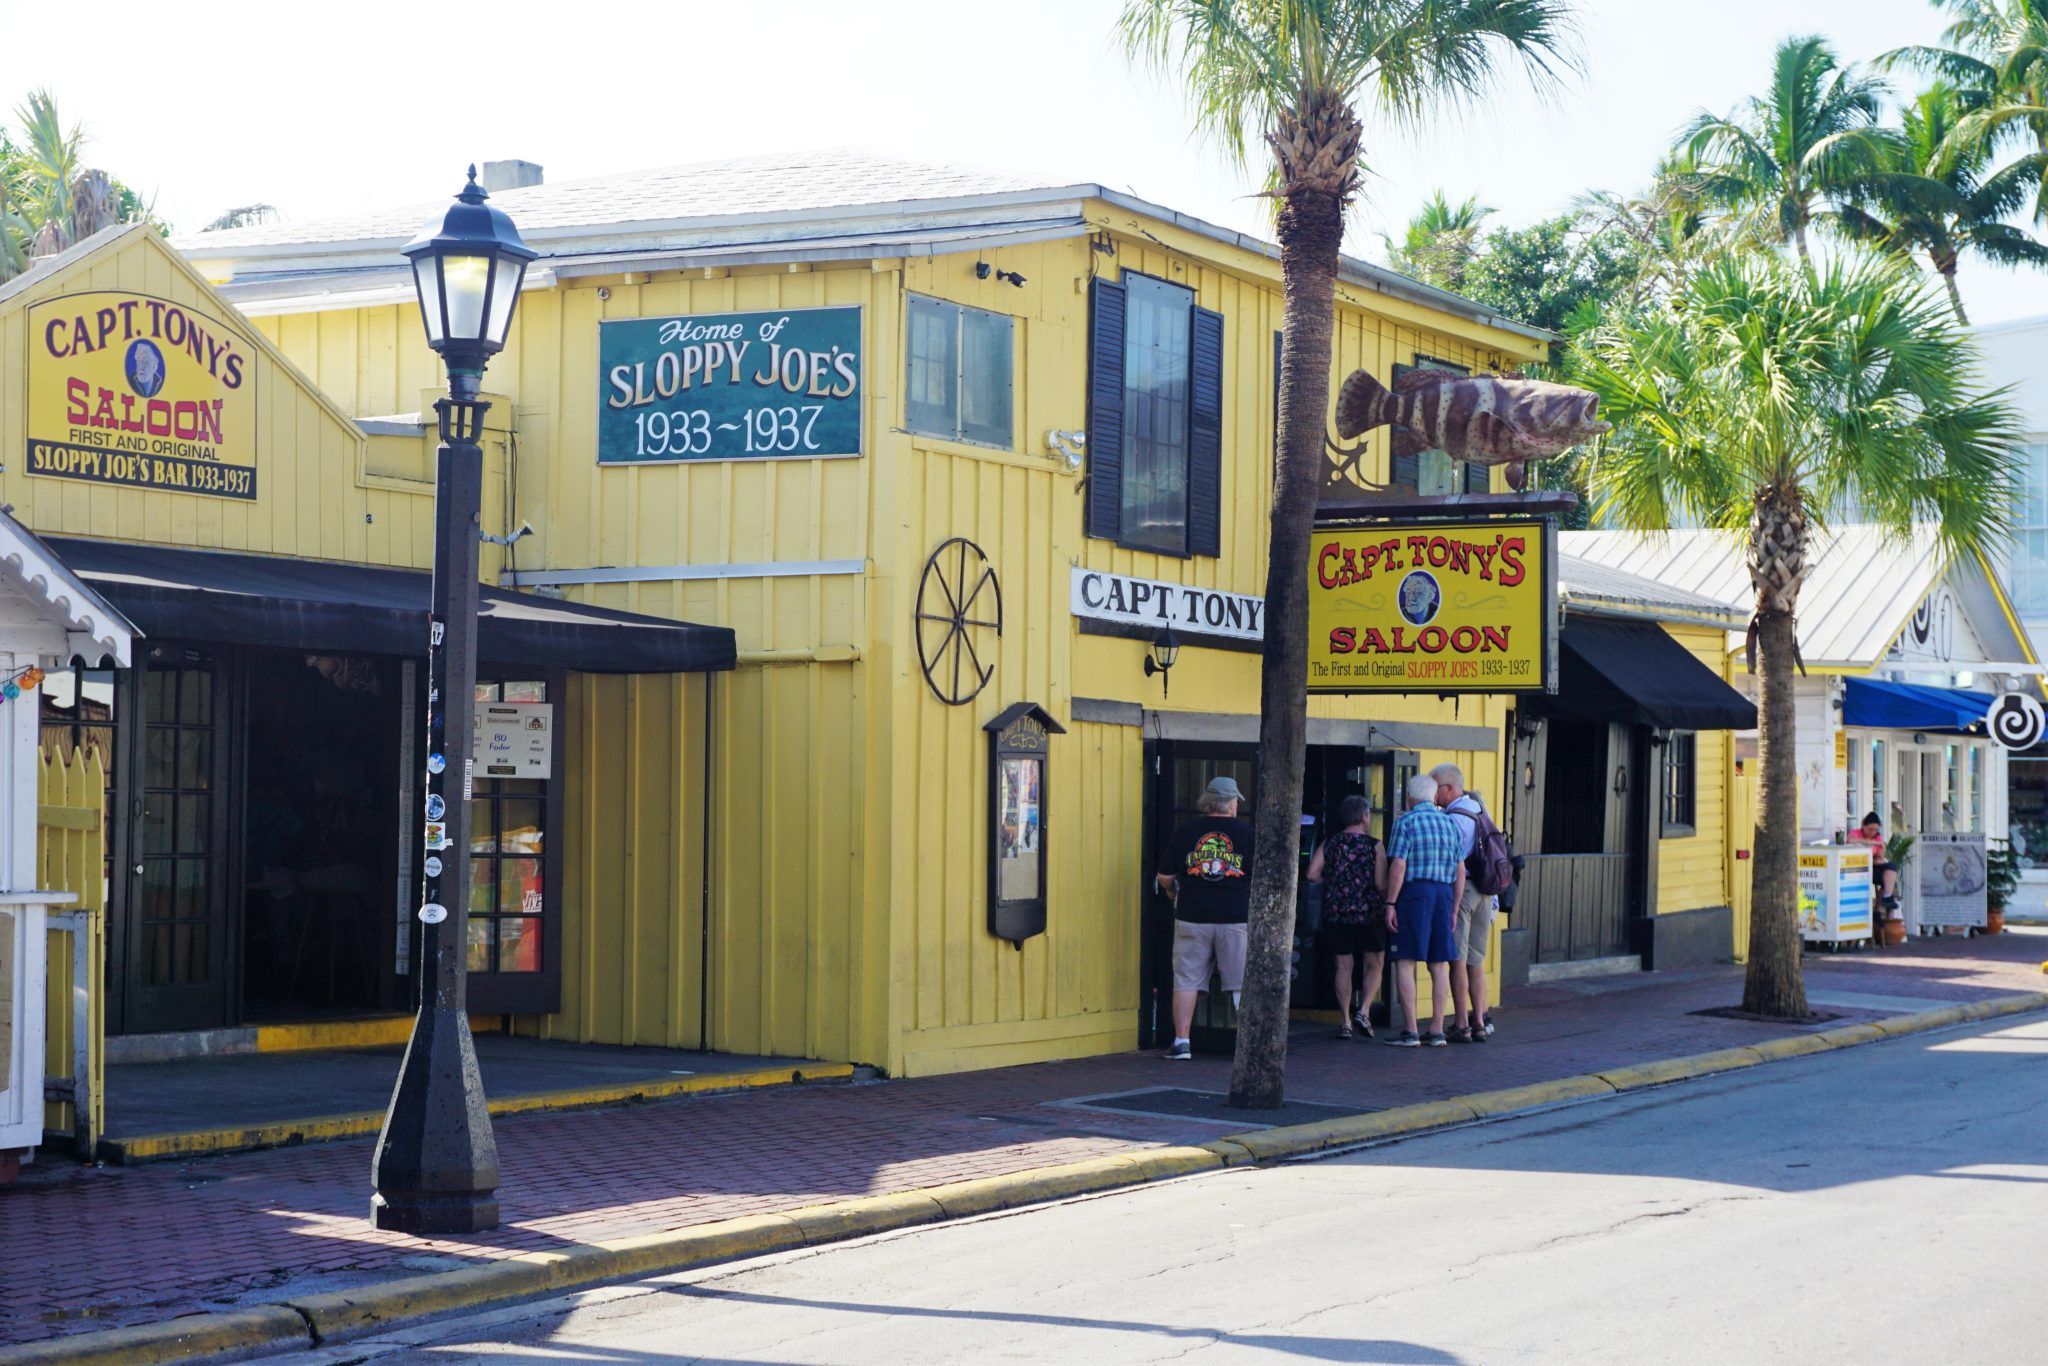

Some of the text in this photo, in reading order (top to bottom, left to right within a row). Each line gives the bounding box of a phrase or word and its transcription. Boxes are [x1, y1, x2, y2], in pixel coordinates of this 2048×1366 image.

[45, 300, 244, 389] CAPT. TONY'S
[659, 316, 789, 344] Home of
[608, 341, 856, 409] SLOPPY JOE'S
[67, 376, 223, 444] SALOON
[34, 444, 251, 494] SLOPPY JOE'S BAR 1933-1937
[70, 428, 220, 461] FIRST AND ORIGINAL
[1318, 534, 1526, 589] CAPT. TONY'S
[1081, 573, 1263, 631] CAPT. TONY
[1330, 626, 1512, 654] SALOON
[1312, 660, 1530, 678] The First and Original SLOPPY JOE'S 1933-1937
[1799, 858, 1824, 867] ENTALS
